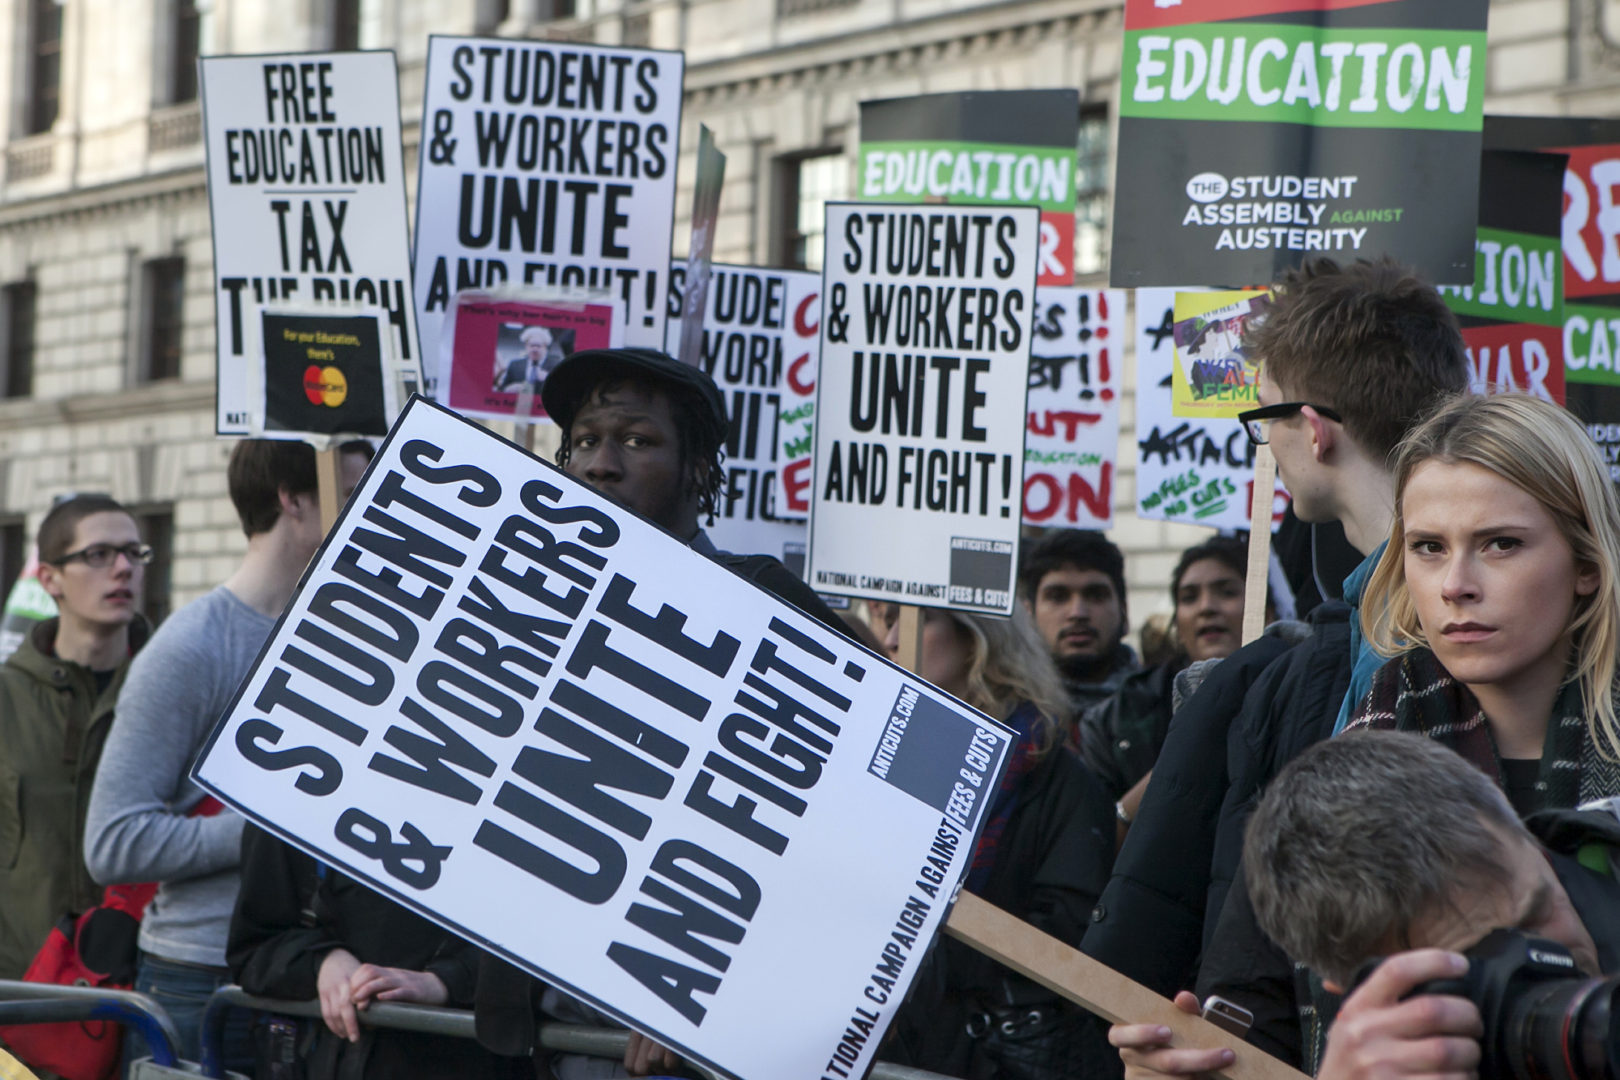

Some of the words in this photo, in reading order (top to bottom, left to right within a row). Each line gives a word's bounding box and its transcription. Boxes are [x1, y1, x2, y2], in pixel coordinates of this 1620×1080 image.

[263, 62, 335, 124] FREE
[450, 45, 659, 114] STUDENTS
[1133, 35, 1472, 114] EDUCATION
[226, 127, 385, 185] EDUCATION
[428, 109, 457, 166] &
[474, 110, 668, 180] WORKERS
[863, 149, 1071, 202] EDUCATION
[457, 173, 634, 259] UNITE
[1182, 203, 1326, 226] ASSEMBLY
[1330, 208, 1404, 224] AGAINST
[1192, 182, 1222, 195] THE
[1229, 176, 1358, 199] STUDENT
[271, 200, 352, 273] TAX
[844, 212, 1016, 279] STUDENTS
[1215, 228, 1367, 250] AUSTERITY
[827, 282, 849, 344] &
[863, 282, 1023, 352] WORKERS
[849, 351, 991, 442] UNITE
[1202, 383, 1258, 401] FEMI
[823, 440, 888, 506] AND
[896, 446, 1012, 519] FIGHT!
[235, 438, 501, 798] STUDENTS
[816, 571, 857, 588] NATIONAL
[860, 575, 903, 592] CAMPAIGN
[902, 581, 946, 599] AGAINST
[949, 585, 973, 604] FEES
[974, 588, 983, 605] &
[984, 591, 1010, 608] CUTS
[367, 479, 620, 805] WORKERS
[472, 573, 742, 906] UNITE
[683, 616, 867, 857] FIGHT!
[870, 686, 920, 780] ANTICUTS.COM
[965, 726, 999, 774] CUTS
[944, 782, 977, 826] FEES
[962, 763, 983, 789] &
[333, 806, 454, 892] &
[915, 817, 963, 897] AGAINST
[605, 839, 762, 1029] AND
[863, 895, 931, 1006] CAMPAIGN
[1528, 949, 1574, 968] Canon
[821, 1006, 881, 1080] TIONAL
